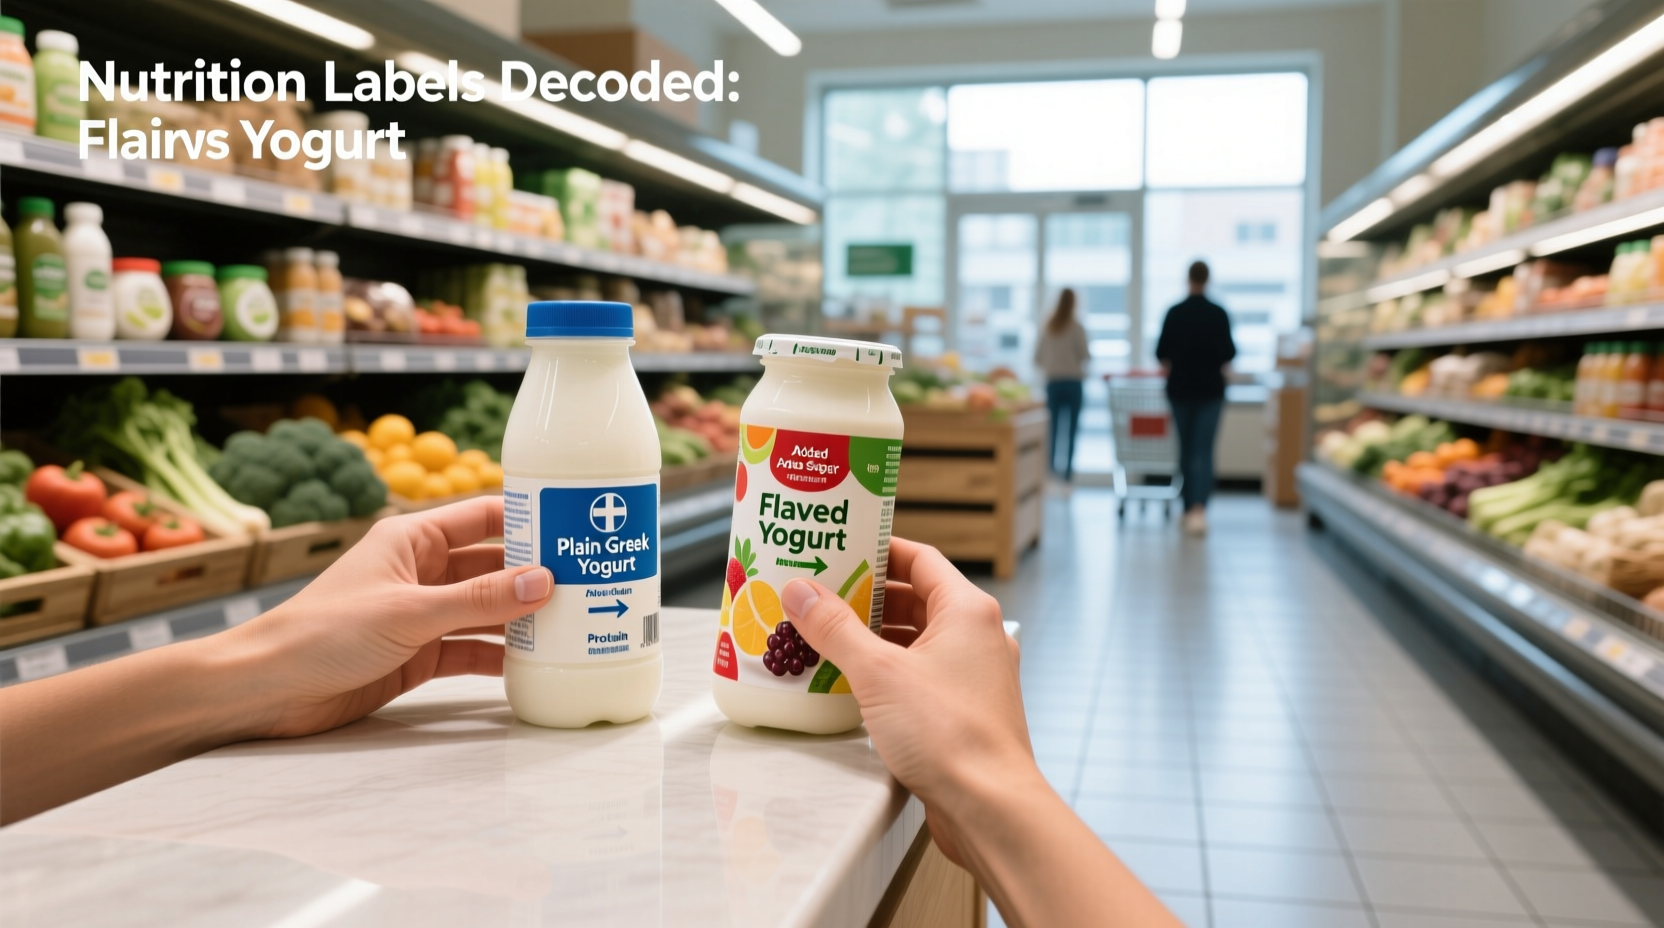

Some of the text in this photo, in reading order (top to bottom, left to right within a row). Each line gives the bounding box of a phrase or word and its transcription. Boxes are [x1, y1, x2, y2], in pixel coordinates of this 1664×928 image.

[759, 492, 849, 525] Flaved
[557, 532, 650, 556] Plain Greek
[758, 520, 847, 555] Yogurt
[577, 556, 636, 579] Yogurt
